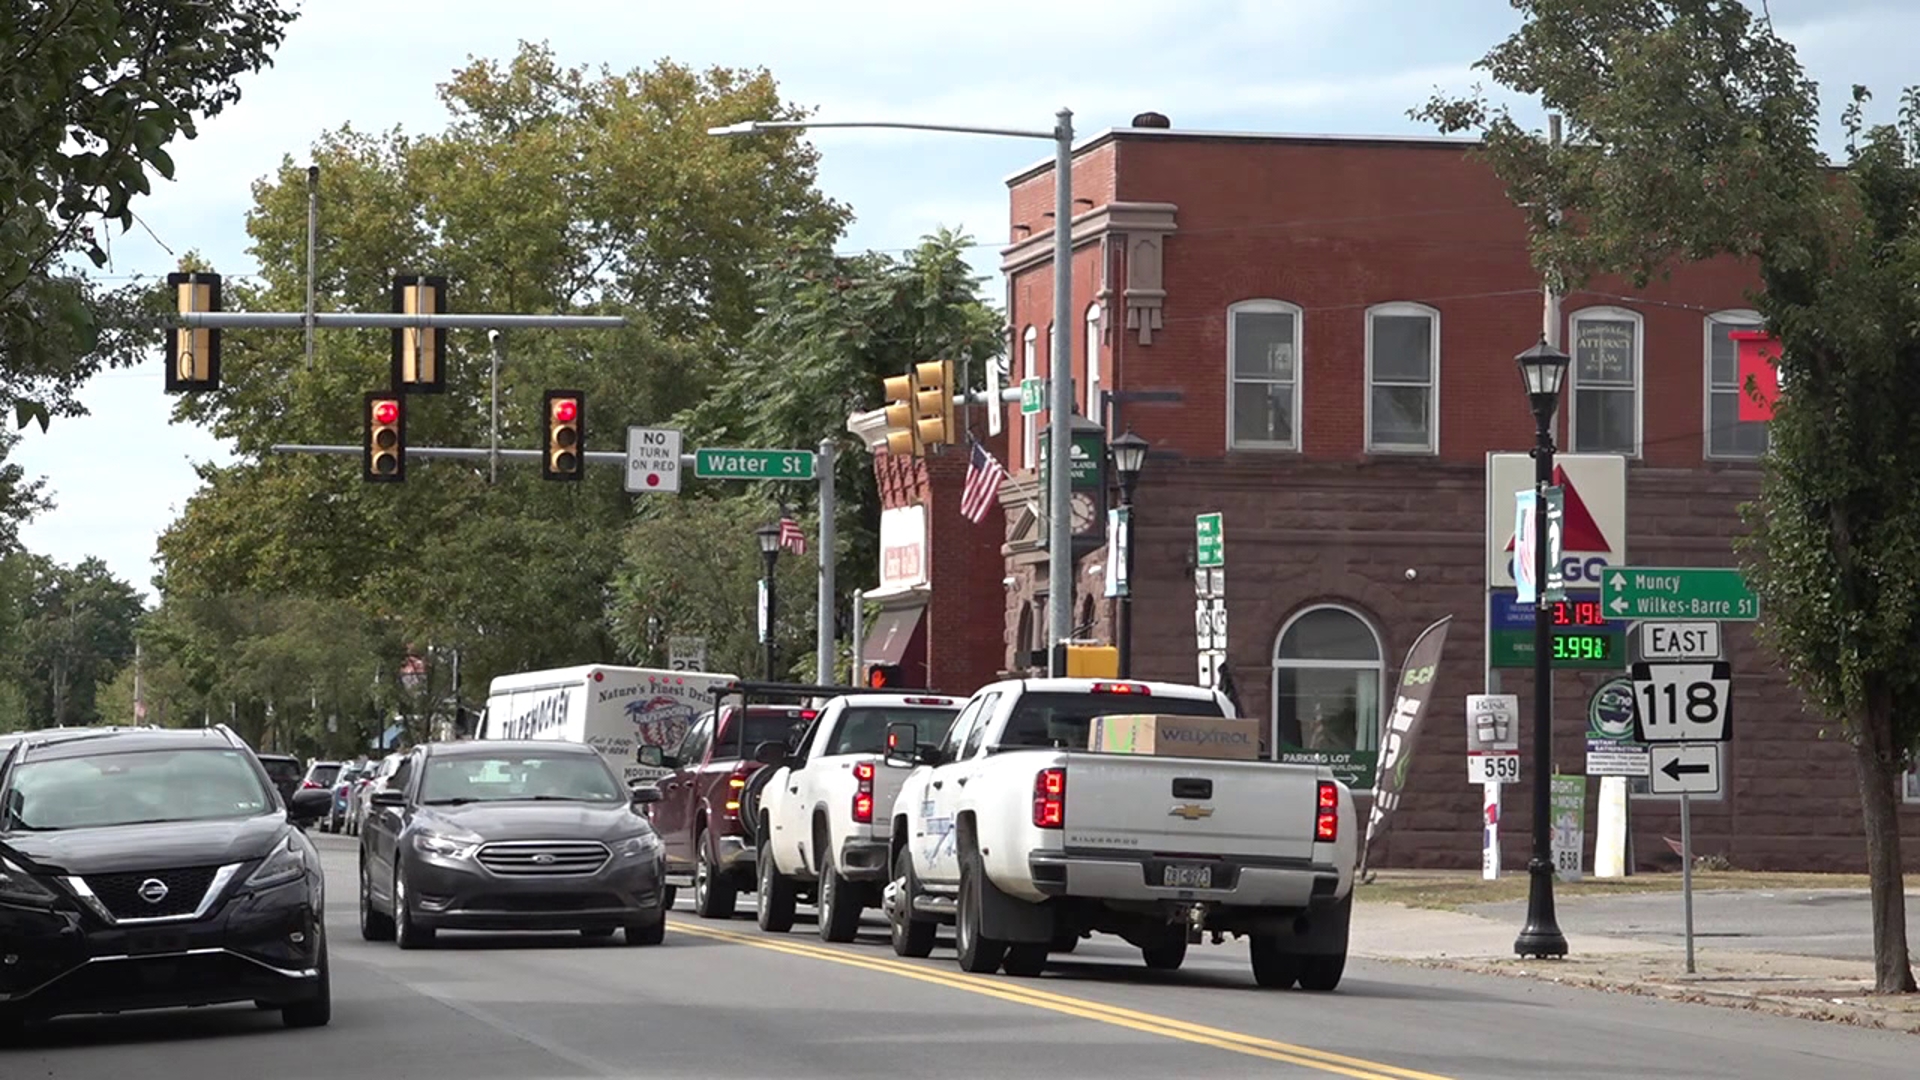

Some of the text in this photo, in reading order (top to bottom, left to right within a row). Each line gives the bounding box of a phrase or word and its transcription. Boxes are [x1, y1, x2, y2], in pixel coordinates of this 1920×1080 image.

[643, 432, 666, 445] NO
[640, 447, 669, 458] TURN
[632, 459, 676, 471] ON RED
[708, 455, 801, 473] Water St
[1636, 575, 1680, 594] Muncy
[1637, 597, 1752, 614] Wilkes-Barre 51
[1653, 628, 1708, 652] EAST
[598, 683, 645, 703] Nature's
[650, 682, 685, 697] Finest
[1643, 682, 1719, 725] 118
[1330, 754, 1351, 763] LOT
[1484, 757, 1517, 778] 559
